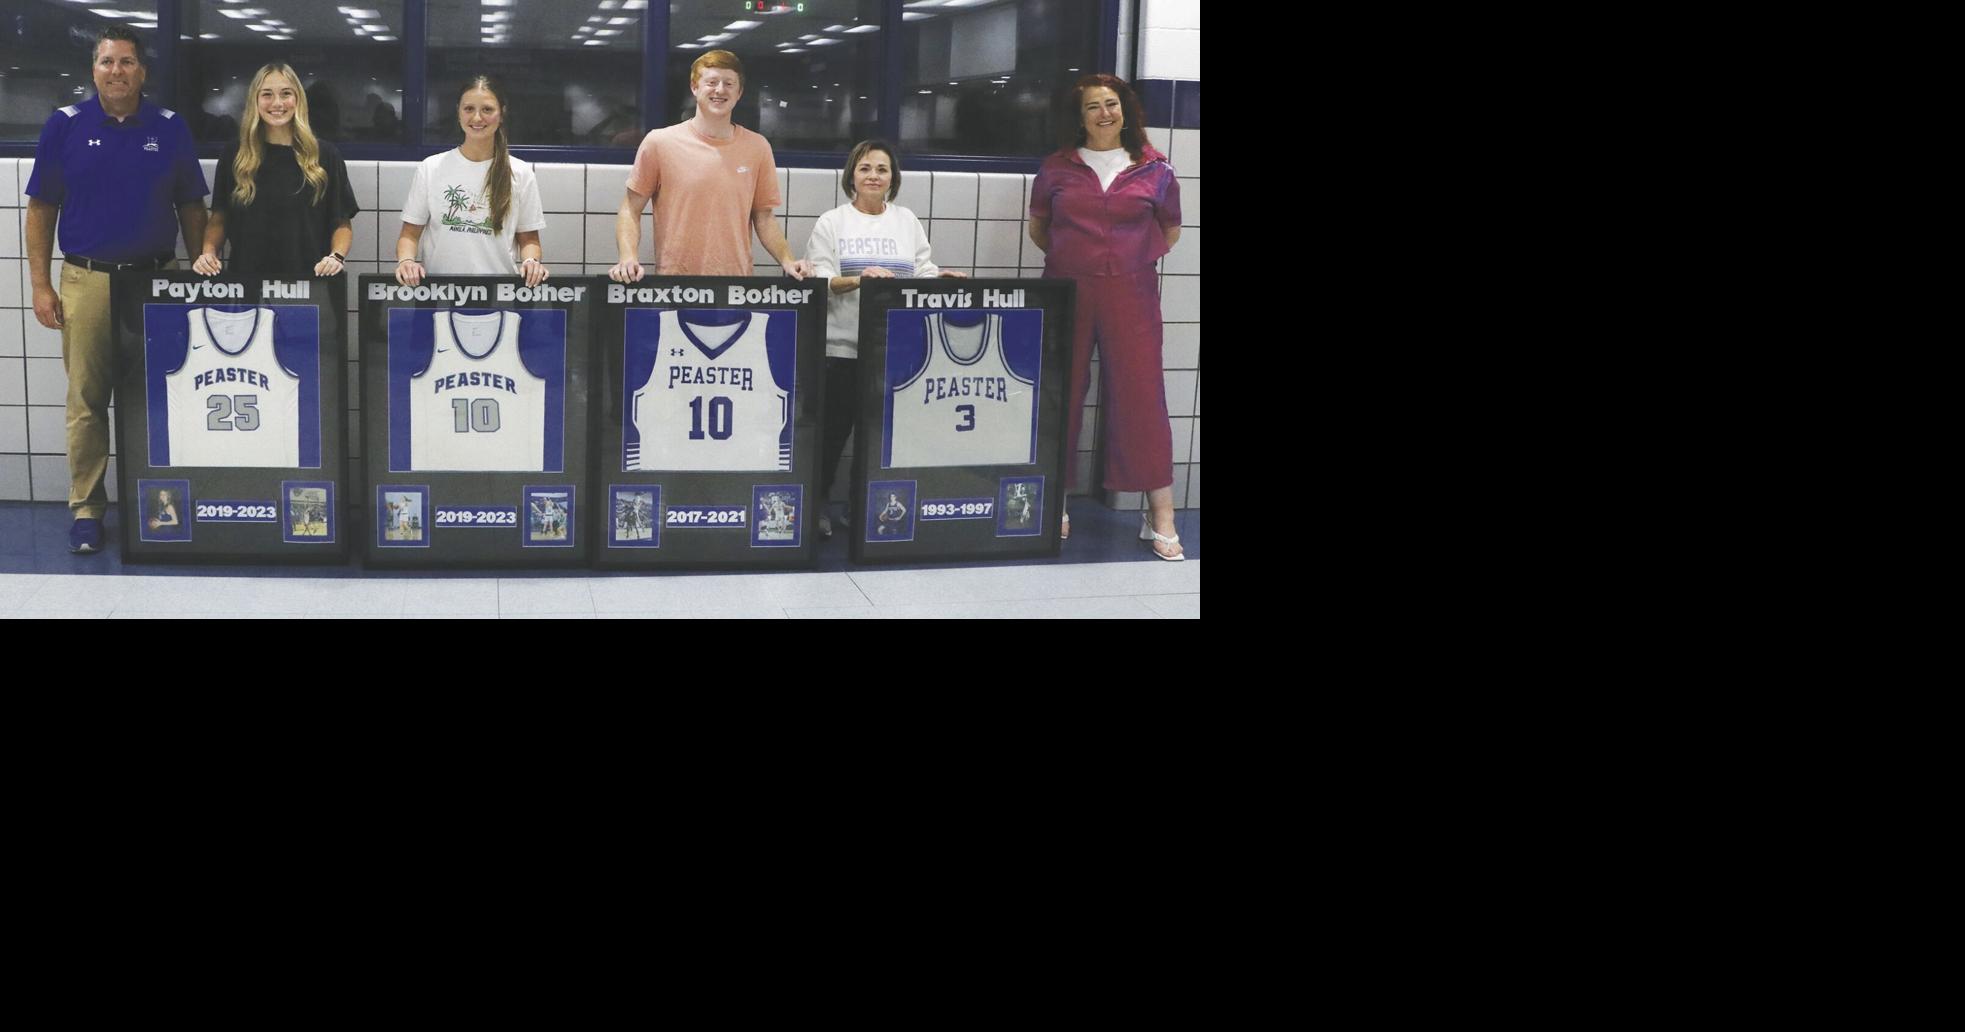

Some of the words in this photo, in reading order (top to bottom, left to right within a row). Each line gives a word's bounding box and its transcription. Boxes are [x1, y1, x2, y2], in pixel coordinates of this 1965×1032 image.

[838, 237, 898, 256] PEASTER
[152, 279, 244, 303] Payton
[262, 280, 310, 299] Hull
[368, 283, 488, 306] Brooklyn
[497, 283, 586, 302] Bosher
[607, 284, 715, 304] Braxton
[728, 285, 813, 305] Bosher
[901, 288, 973, 308] Travis
[982, 288, 1025, 308] Hull
[194, 367, 270, 391] PEASTER
[434, 371, 517, 395] PEASTER
[668, 366, 753, 391] PEASTER
[924, 377, 1007, 404] PEASTER
[206, 394, 260, 431] 25
[452, 398, 501, 433] 10
[688, 396, 733, 440] 10
[955, 404, 976, 432] 3
[197, 505, 277, 518] 2019-2023
[436, 510, 517, 523] 2019-2023
[667, 511, 745, 523] 2017-2021
[921, 503, 993, 516] 1993-1997
